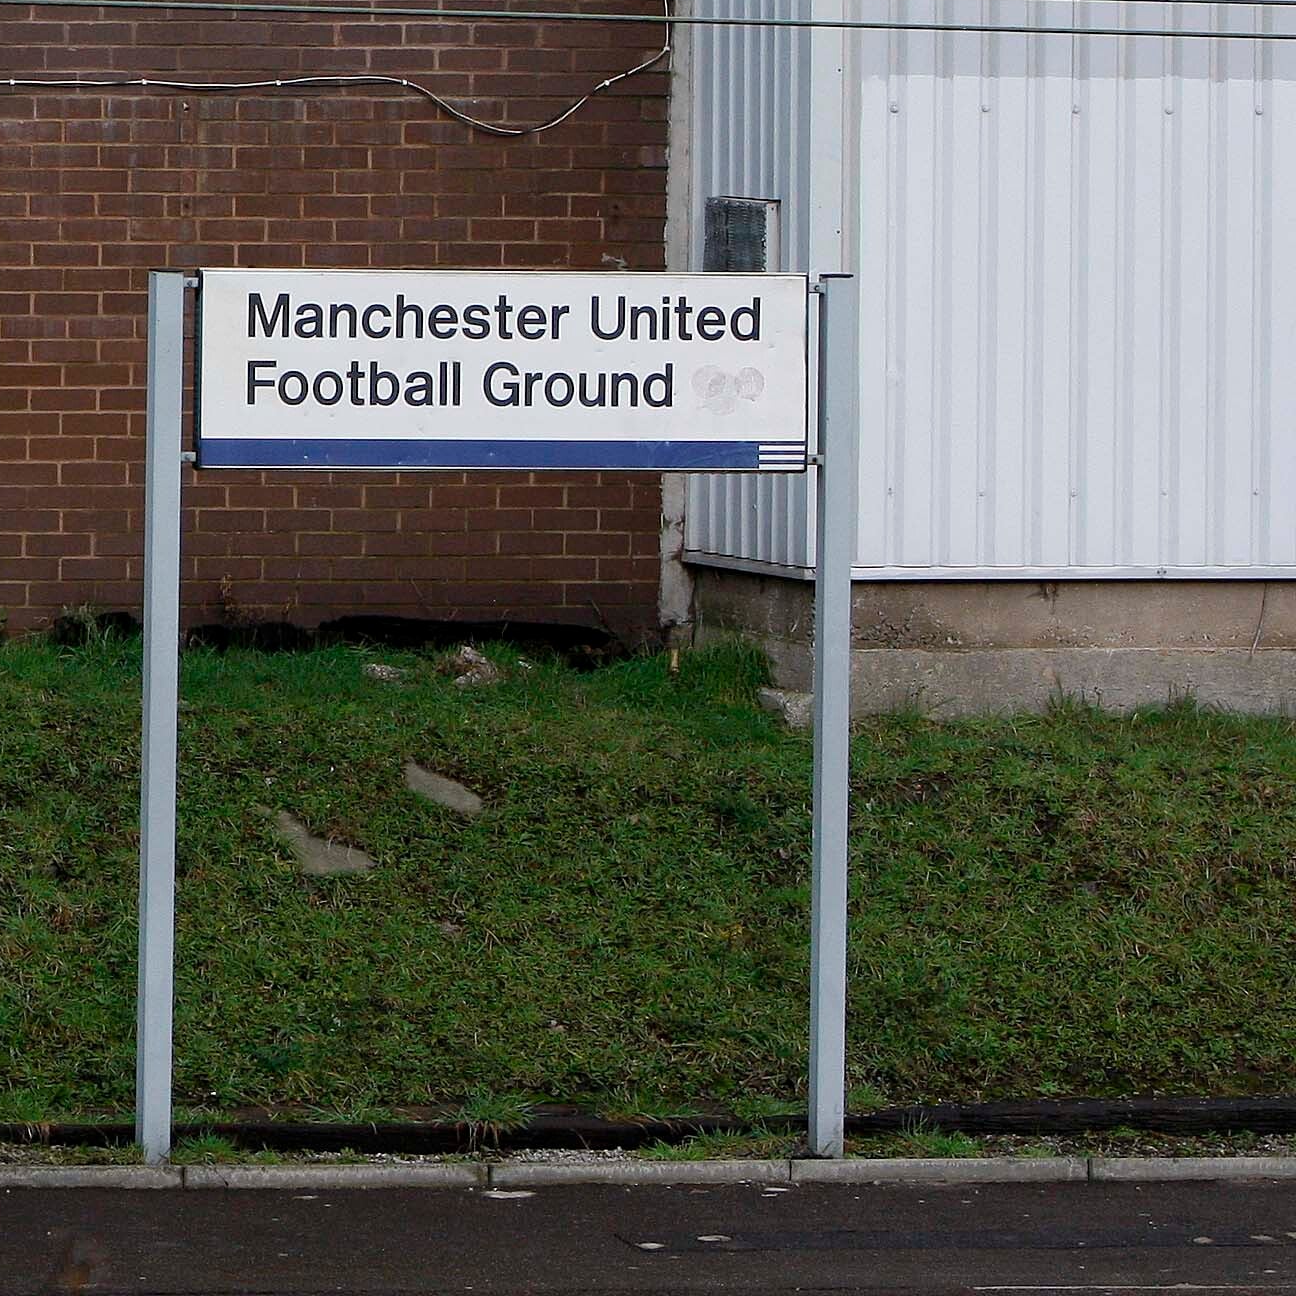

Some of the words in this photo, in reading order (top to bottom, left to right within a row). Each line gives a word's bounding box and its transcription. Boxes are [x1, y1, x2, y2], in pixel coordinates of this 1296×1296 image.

[248, 293, 569, 339] Manchester
[592, 296, 760, 341] United
[248, 361, 460, 406] Football
[484, 362, 672, 407] Ground
